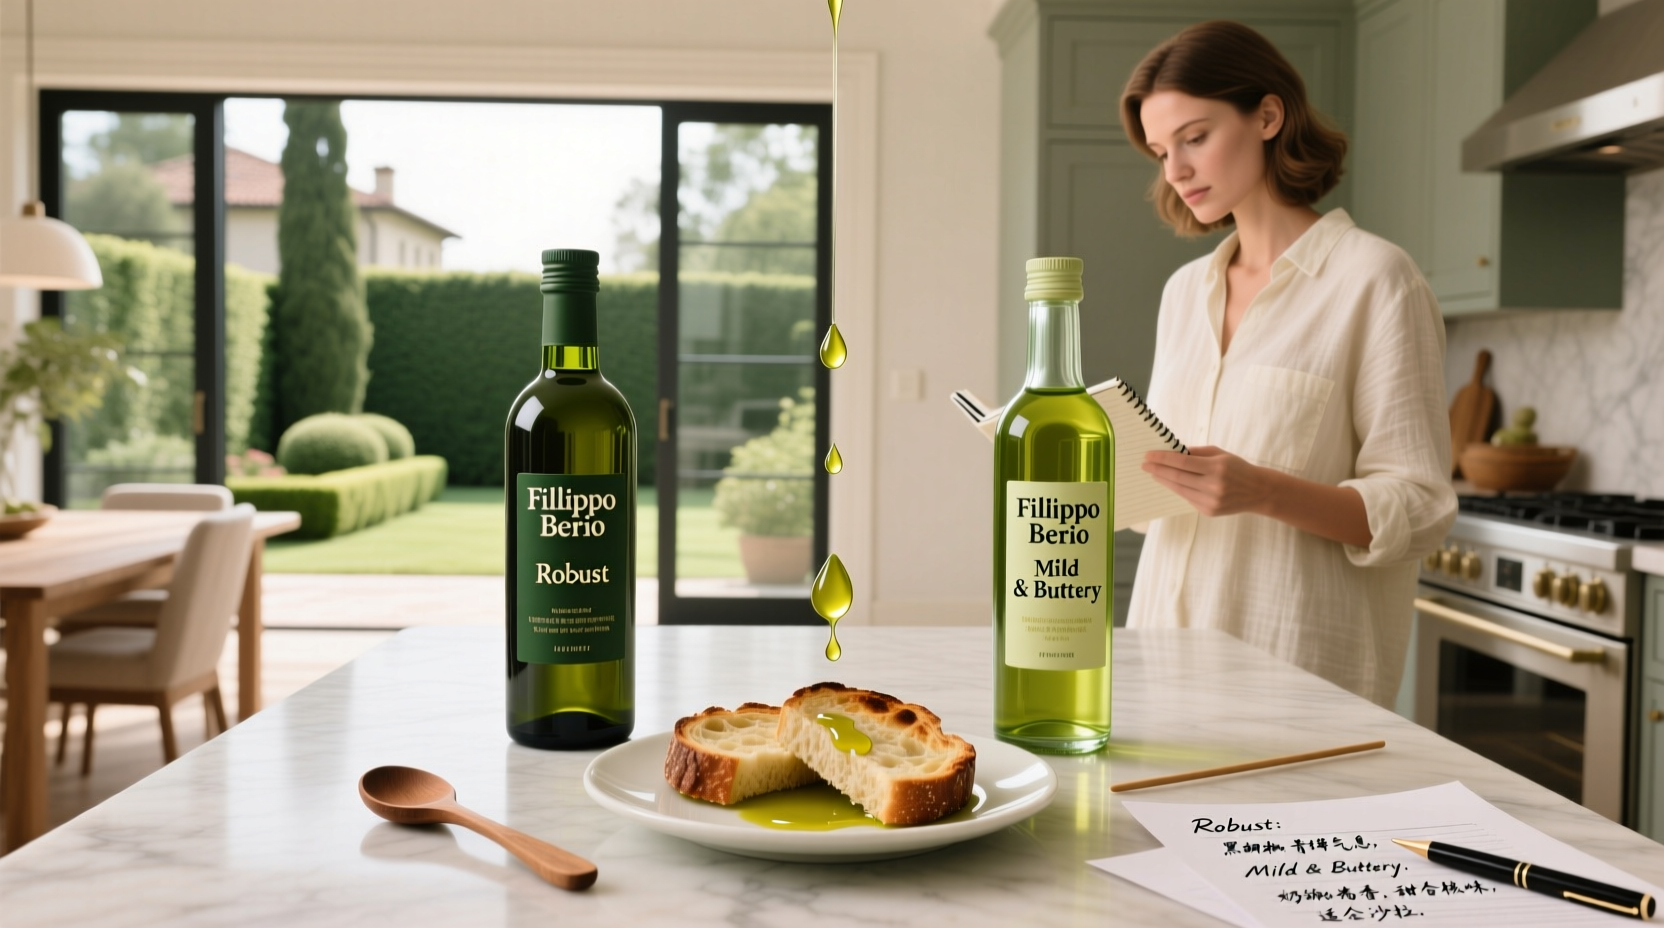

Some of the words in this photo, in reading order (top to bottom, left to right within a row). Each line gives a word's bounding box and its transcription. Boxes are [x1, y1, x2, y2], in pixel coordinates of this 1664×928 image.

[527, 486, 617, 518] Fillippo
[1017, 497, 1100, 525] Fillippo
[540, 514, 606, 538] Berio
[1028, 523, 1090, 545] Berio
[535, 562, 610, 585] Robust
[1034, 558, 1079, 578] Mild
[1013, 578, 1029, 598] &
[1034, 580, 1103, 604] Buttery
[1191, 817, 1282, 834] Robust:
[1245, 861, 1298, 878] Mild
[1305, 863, 1322, 875] &
[1331, 860, 1409, 879] Buttery.
